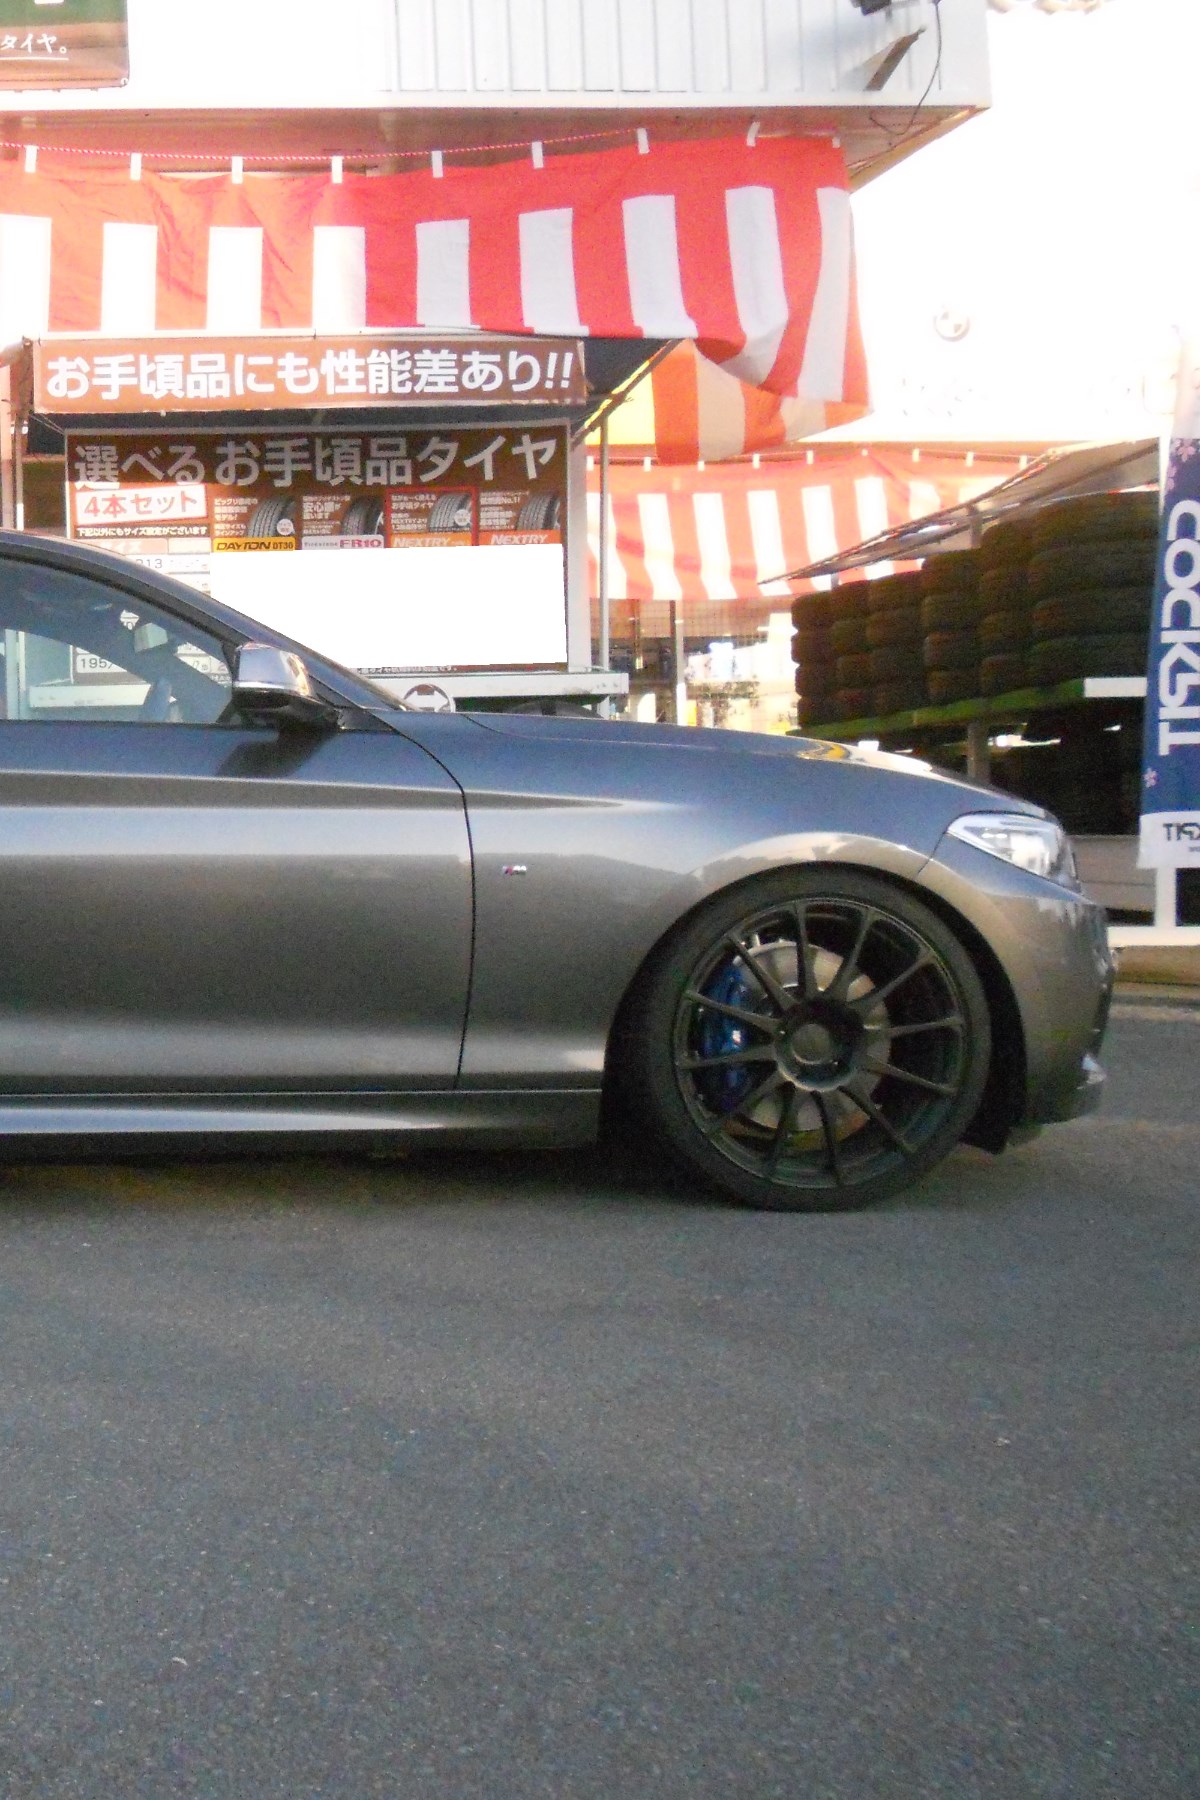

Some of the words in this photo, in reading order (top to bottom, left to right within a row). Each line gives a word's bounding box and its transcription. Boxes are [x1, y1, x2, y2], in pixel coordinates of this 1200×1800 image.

[45, 350, 575, 402] お手頃品にも性能差あり!!
[73, 432, 559, 491] 選べるお手頃品タイヤ
[83, 491, 198, 518] 4本セット
[216, 541, 271, 551] DAYTON
[393, 537, 450, 548] NEXTRY
[490, 533, 548, 545] NEXTRY
